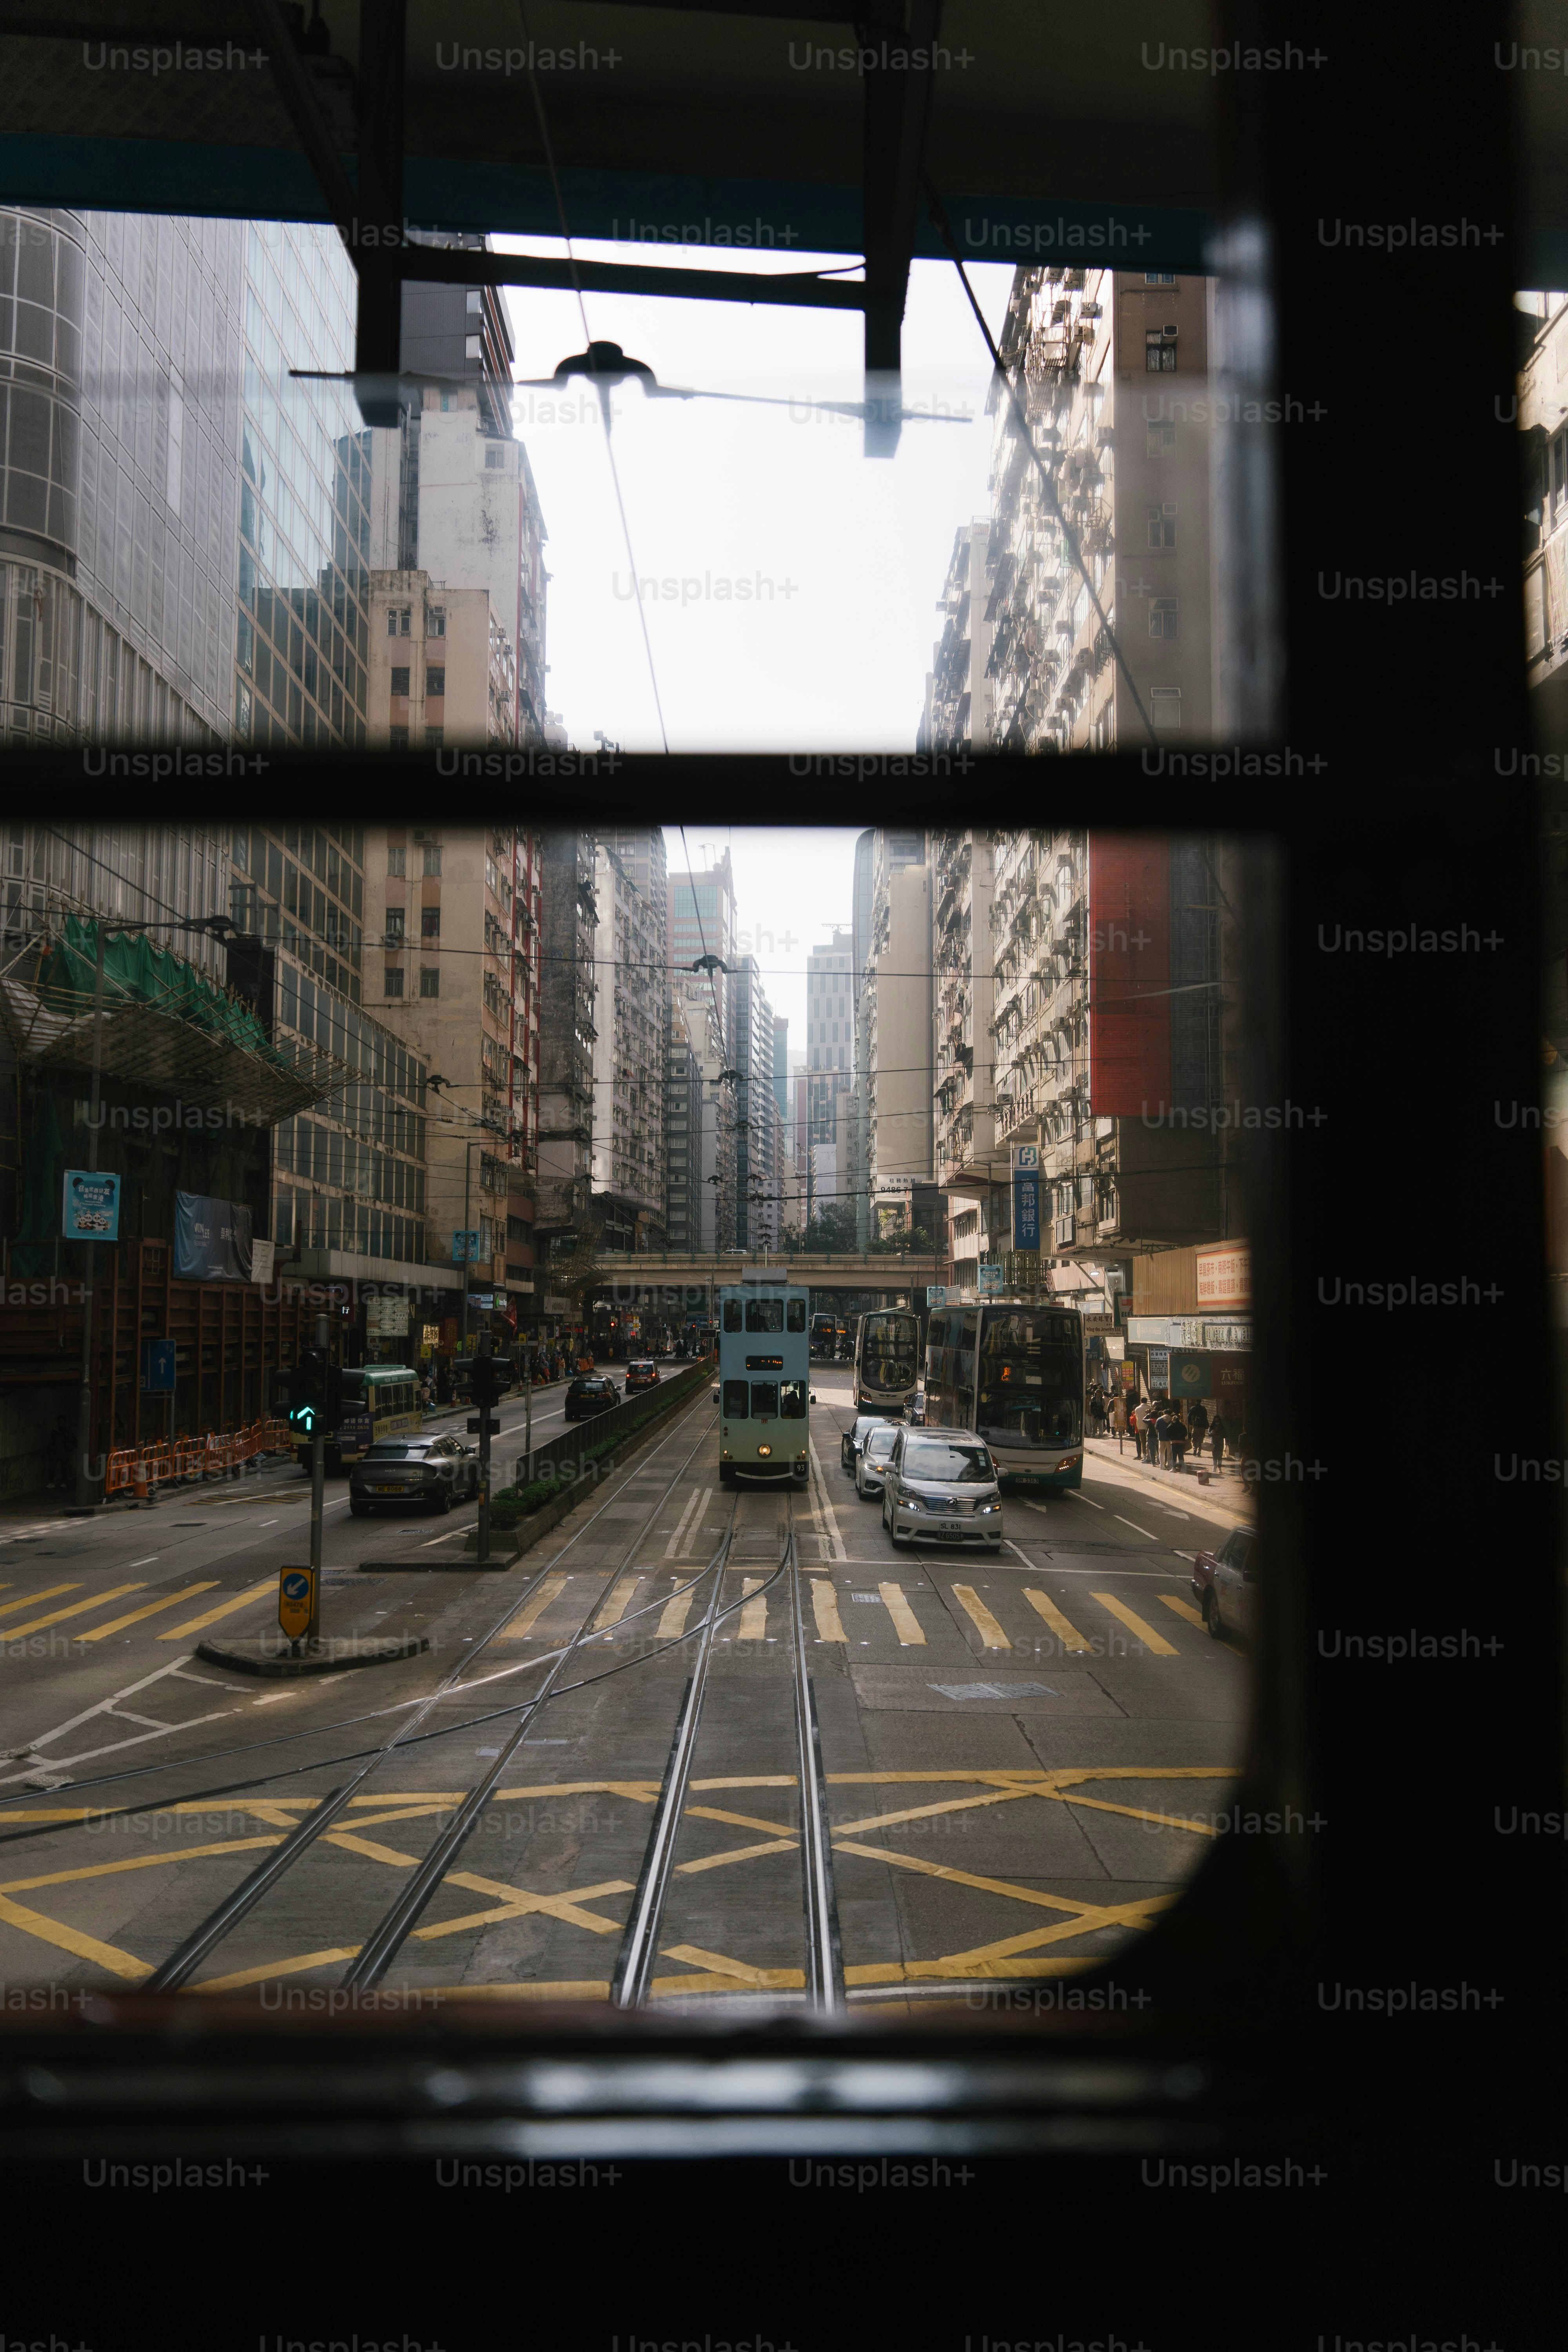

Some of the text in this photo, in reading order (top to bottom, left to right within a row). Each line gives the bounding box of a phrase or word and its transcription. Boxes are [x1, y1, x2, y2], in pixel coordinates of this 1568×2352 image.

[1021, 1178, 1035, 1237] 富邦銀行
[1221, 1368, 1245, 1380] 六福
